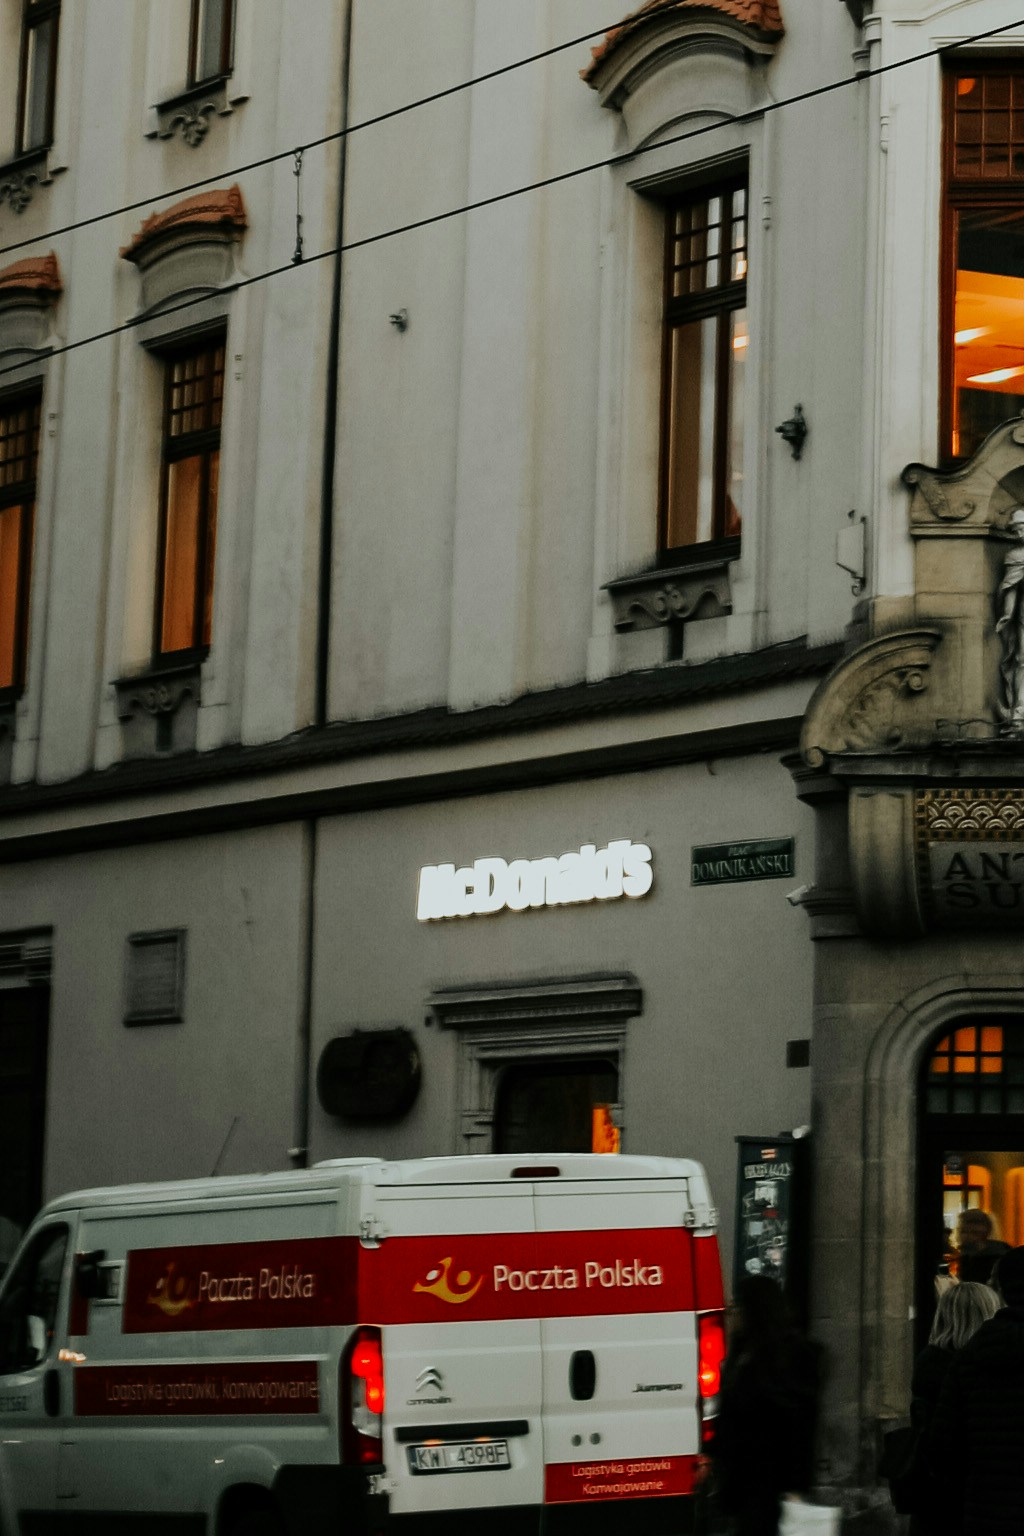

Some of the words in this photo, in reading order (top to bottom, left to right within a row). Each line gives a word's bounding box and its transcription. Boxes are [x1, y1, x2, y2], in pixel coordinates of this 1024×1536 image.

[417, 839, 653, 920] McDonald's
[199, 1271, 255, 1302] Poczta
[258, 1265, 315, 1300] Polska
[493, 1264, 577, 1292] Poczta
[585, 1258, 662, 1287] Polska
[572, 1463, 624, 1479] Logistyka
[582, 1480, 664, 1495] Konwojowanie
